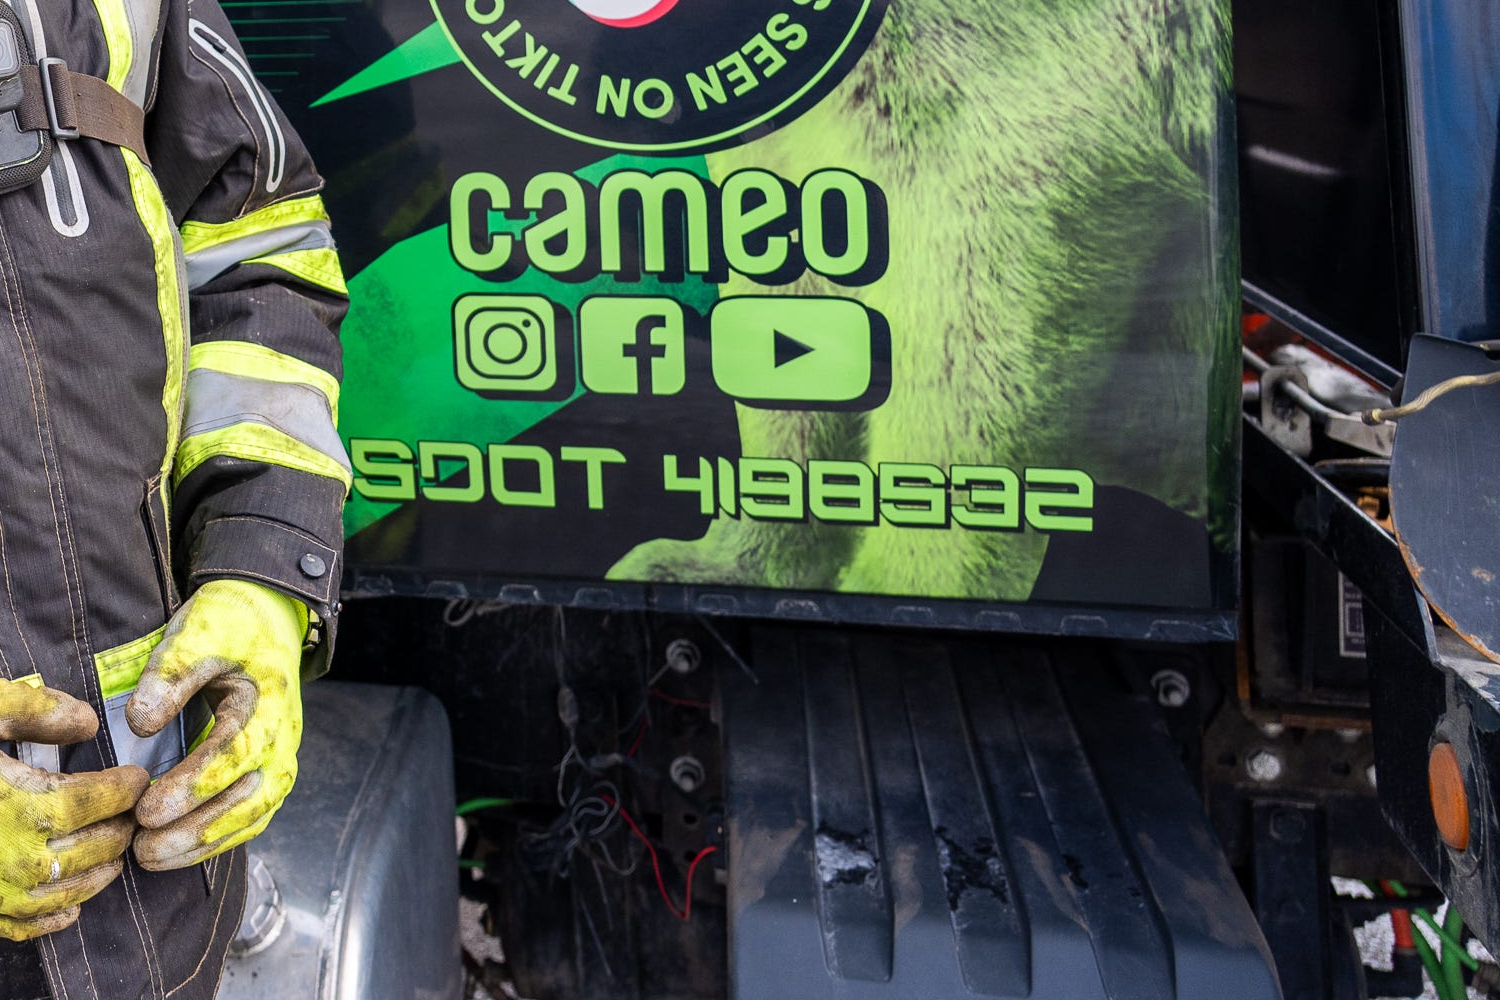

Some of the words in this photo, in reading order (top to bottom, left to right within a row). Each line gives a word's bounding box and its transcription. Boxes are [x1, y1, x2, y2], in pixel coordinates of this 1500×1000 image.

[595, 74, 673, 119] ON
[685, 13, 809, 112] SEEN
[449, 169, 869, 277] cameo
[350, 438, 628, 510] SDOT
[663, 454, 1095, 532] 4198532
